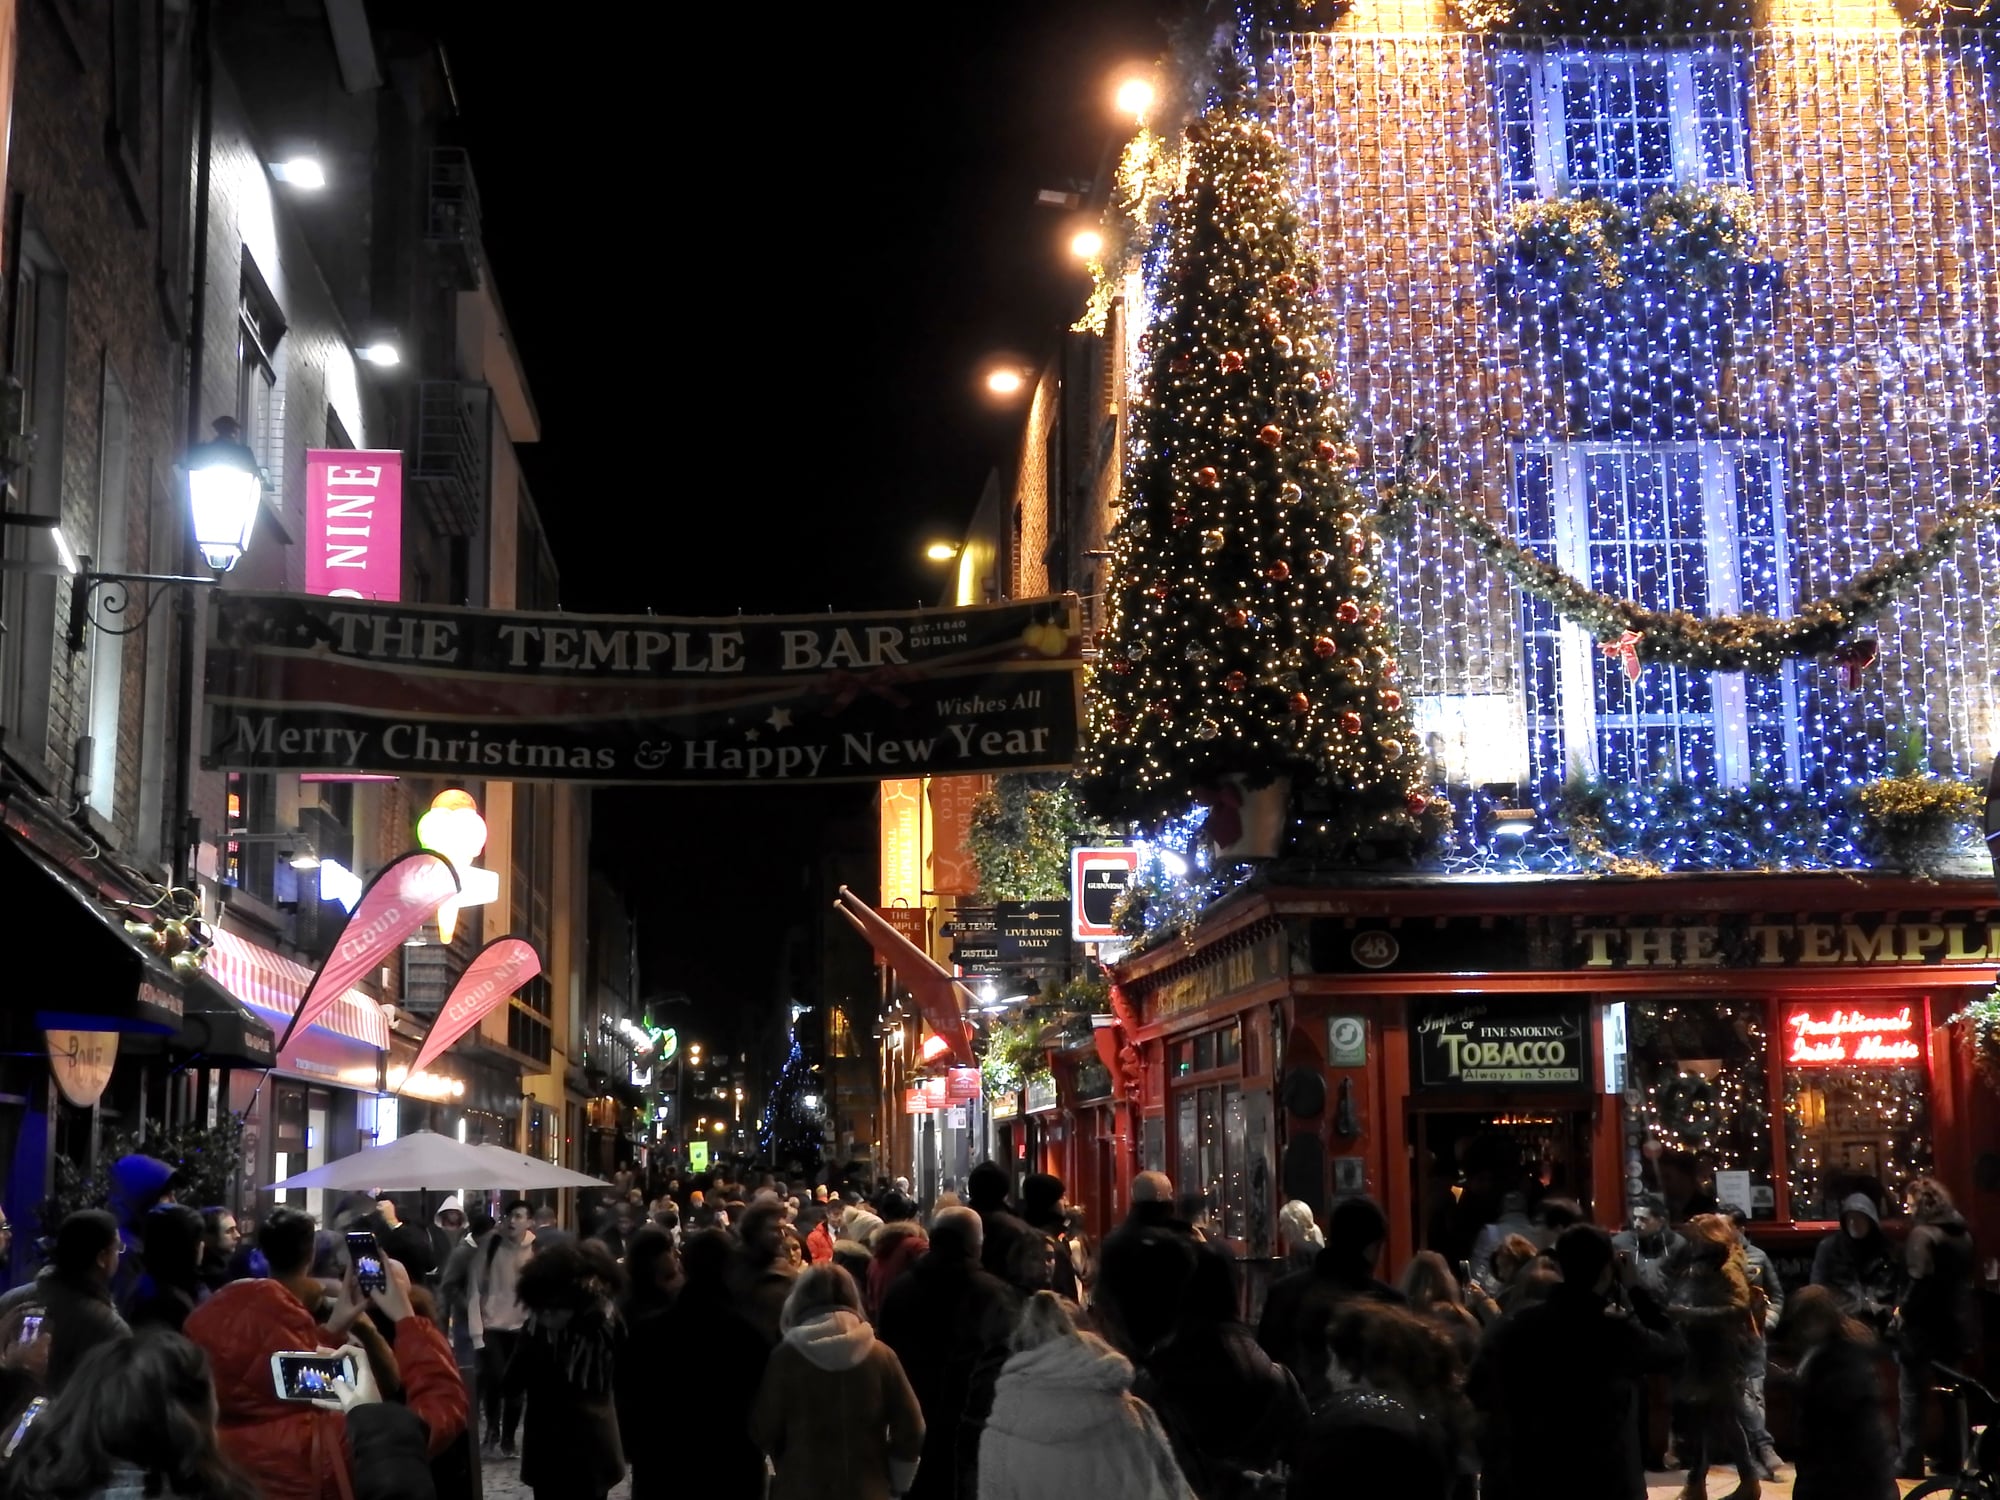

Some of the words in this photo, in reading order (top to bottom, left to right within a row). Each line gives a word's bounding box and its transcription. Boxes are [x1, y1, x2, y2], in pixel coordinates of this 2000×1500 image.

[326, 465, 382, 569] NINE
[328, 611, 459, 662] THE
[498, 624, 745, 672] TEMPLE
[780, 626, 908, 670] BAR
[910, 633, 968, 648] DUBLIN
[936, 695, 1006, 718] Wishes
[1012, 690, 1041, 710] All
[236, 715, 368, 766] Merry
[382, 724, 615, 769] Christmas
[634, 740, 672, 769] &
[684, 739, 828, 778] Happy
[842, 732, 936, 766] New
[948, 723, 1049, 758] Year
[899, 808, 912, 837] THE
[900, 840, 912, 896] TEMPLE
[1087, 882, 1125, 890] GUINNESS
[890, 911, 911, 920] THE
[949, 922, 966, 931] THE
[341, 908, 401, 962] CLOUD
[1005, 928, 1029, 937] LIVE
[1030, 928, 1063, 937] MUSIC
[1018, 939, 1050, 948] DAILY
[1575, 926, 1721, 966] THE
[1359, 936, 1389, 959] 48
[449, 980, 496, 1022] CLOUD
[494, 947, 530, 984] NINE
[1461, 1021, 1475, 1030] OF
[1481, 1026, 1508, 1038] FINE
[1510, 1026, 1564, 1037] SMOKING
[1785, 1007, 1913, 1036] Traditional
[1437, 1034, 1566, 1077] TOBACCO
[1789, 1036, 1846, 1062] Irish
[1853, 1035, 1920, 1060] Music
[1464, 1069, 1513, 1082] Always
[1520, 1068, 1533, 1079] in
[1538, 1068, 1577, 1079] Stock
